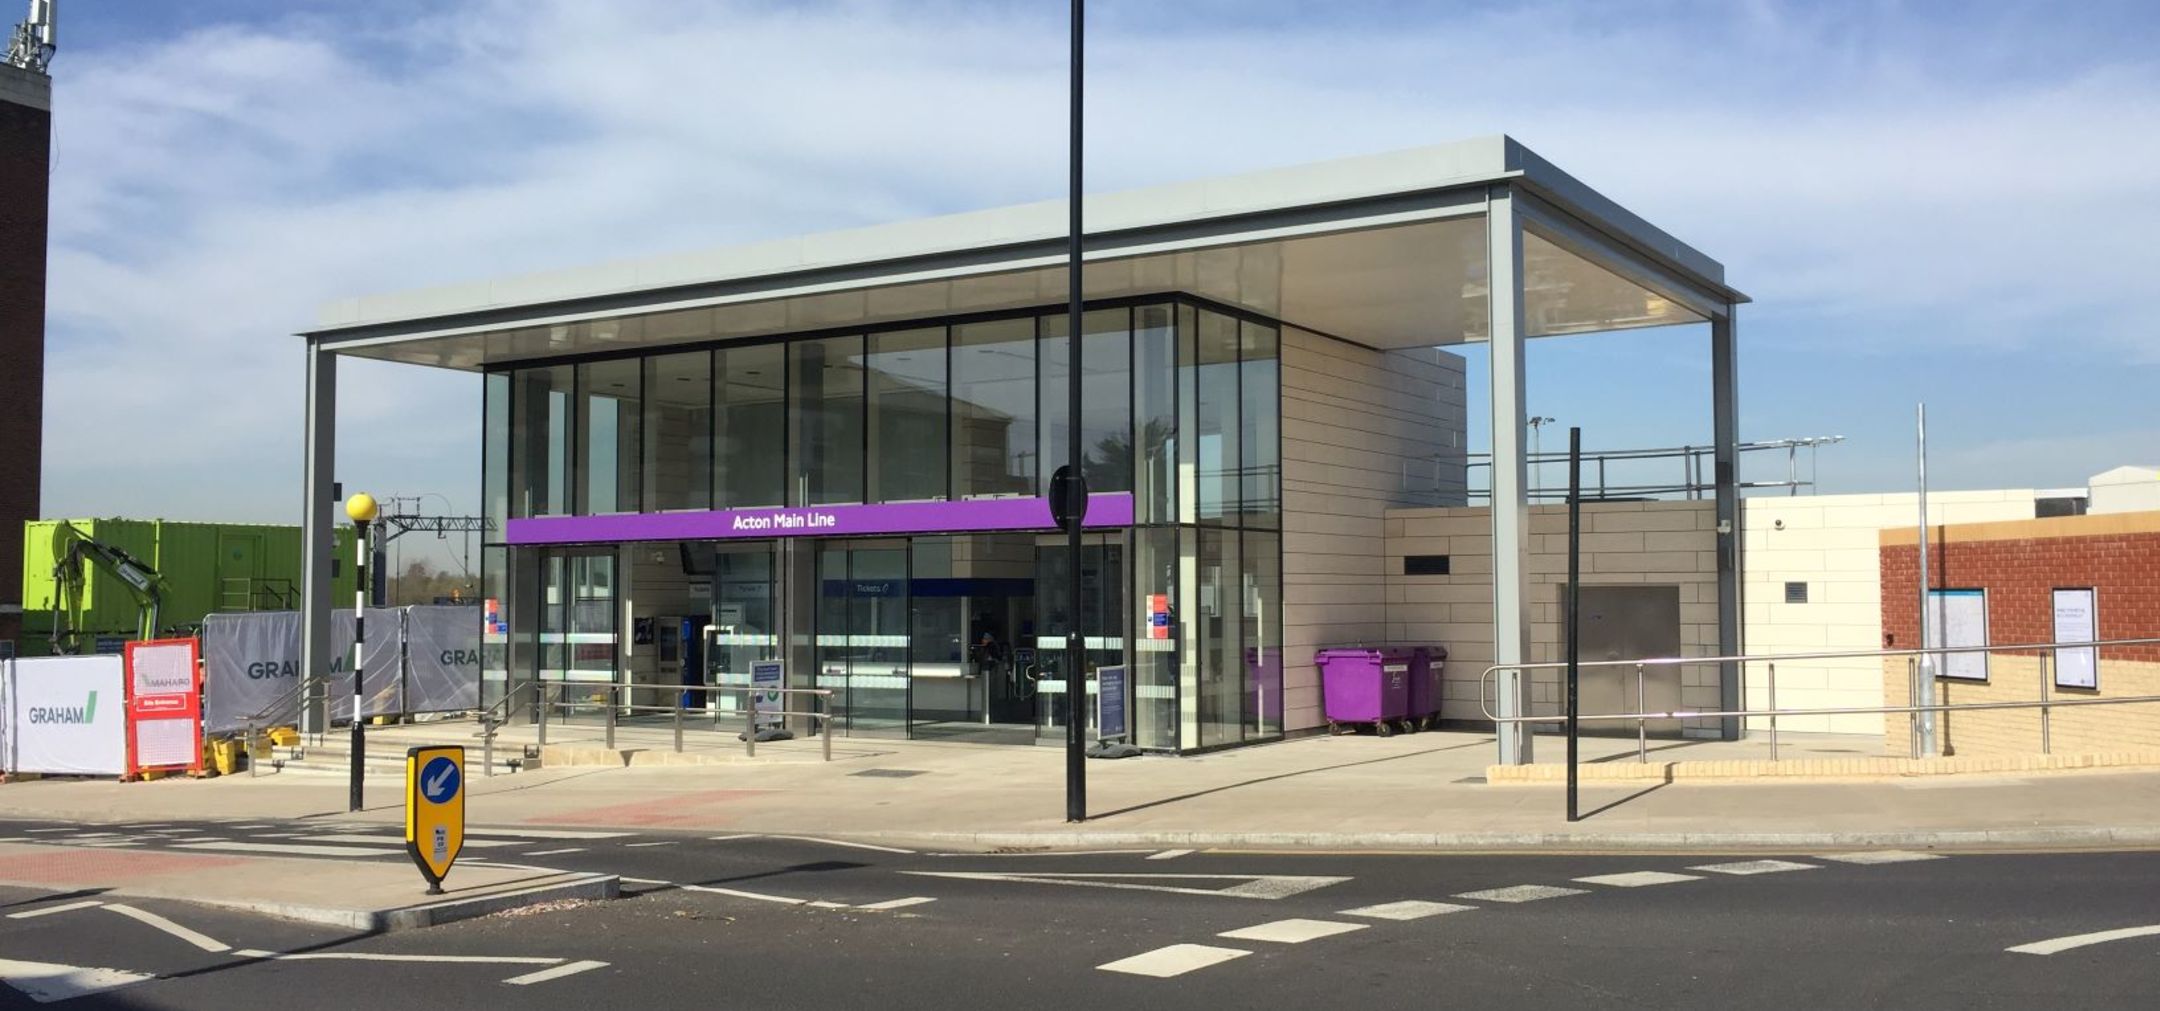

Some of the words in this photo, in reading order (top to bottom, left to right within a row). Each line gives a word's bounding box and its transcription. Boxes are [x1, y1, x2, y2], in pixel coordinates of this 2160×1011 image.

[733, 515, 771, 530] Acton
[774, 513, 804, 529] Main
[807, 512, 836, 527] Line
[857, 584, 881, 593] Tickets
[29, 707, 84, 724] GRAHAM
